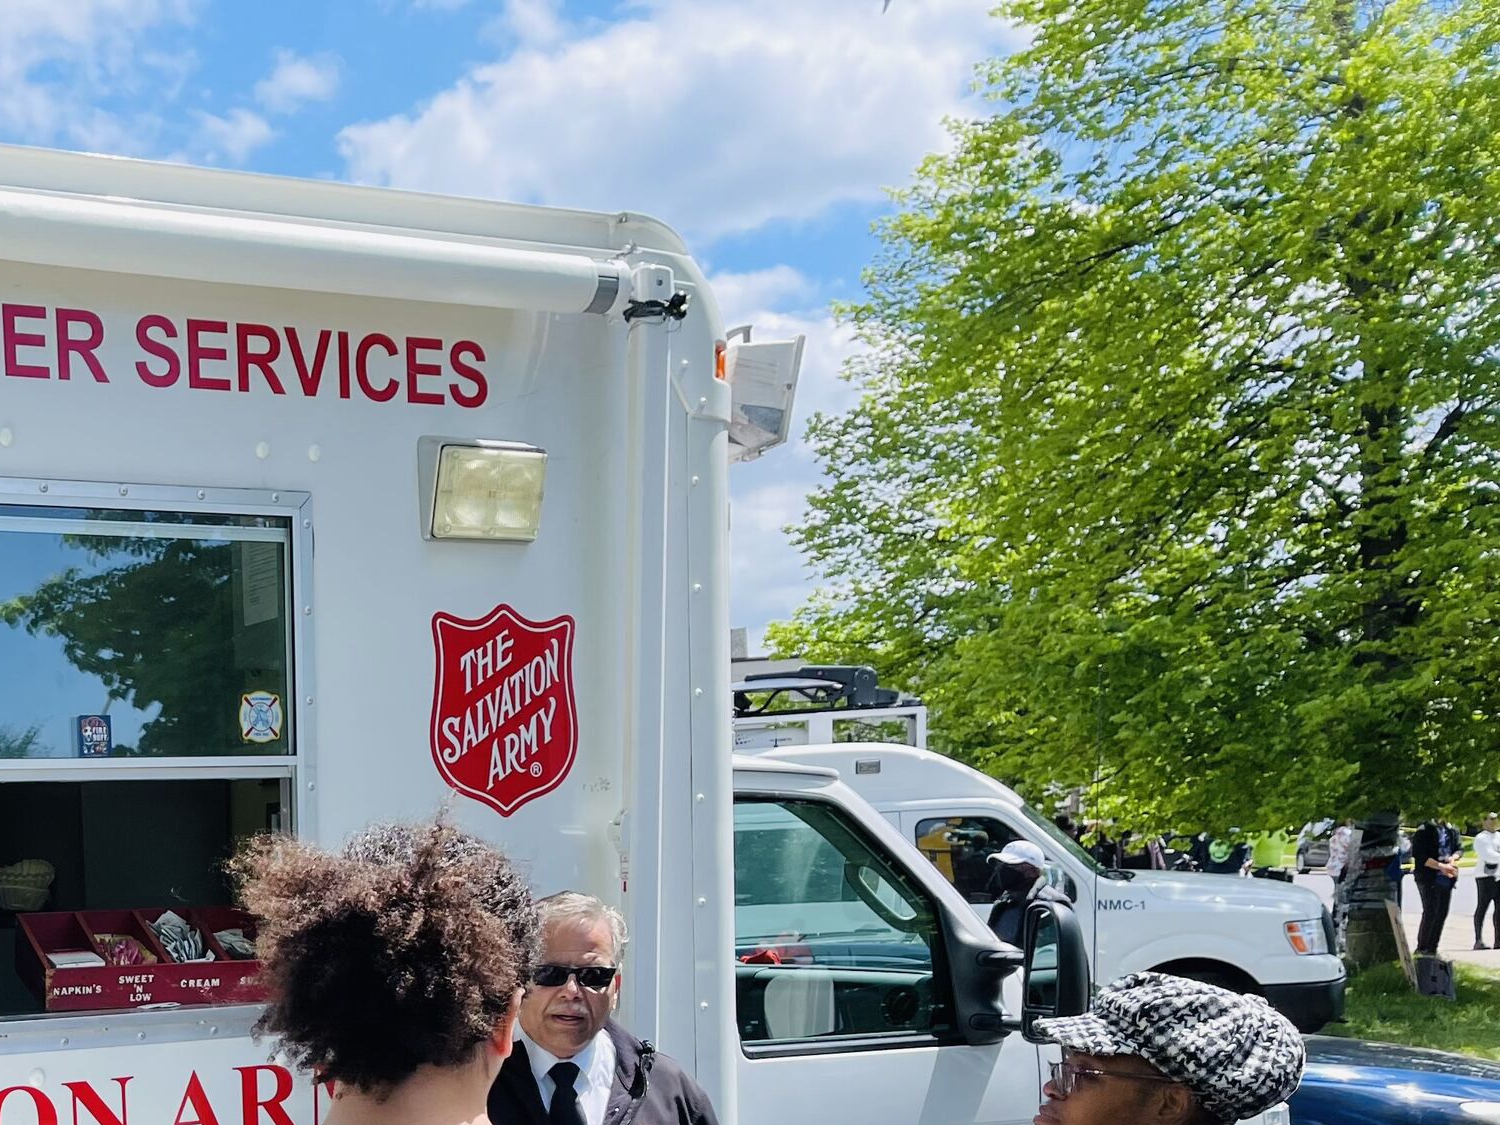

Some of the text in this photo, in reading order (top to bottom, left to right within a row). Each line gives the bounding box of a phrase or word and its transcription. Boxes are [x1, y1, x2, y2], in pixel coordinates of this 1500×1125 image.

[134, 313, 490, 409] SERVICES
[460, 629, 514, 694] THE
[442, 638, 559, 763] SALVATION
[486, 697, 556, 790] ARMY
[1097, 899, 1146, 911] NMC-1
[118, 974, 155, 984] SWEET
[180, 978, 221, 988] CREAM
[53, 983, 102, 996] NAPKIN'S
[129, 993, 152, 1002] LOW
